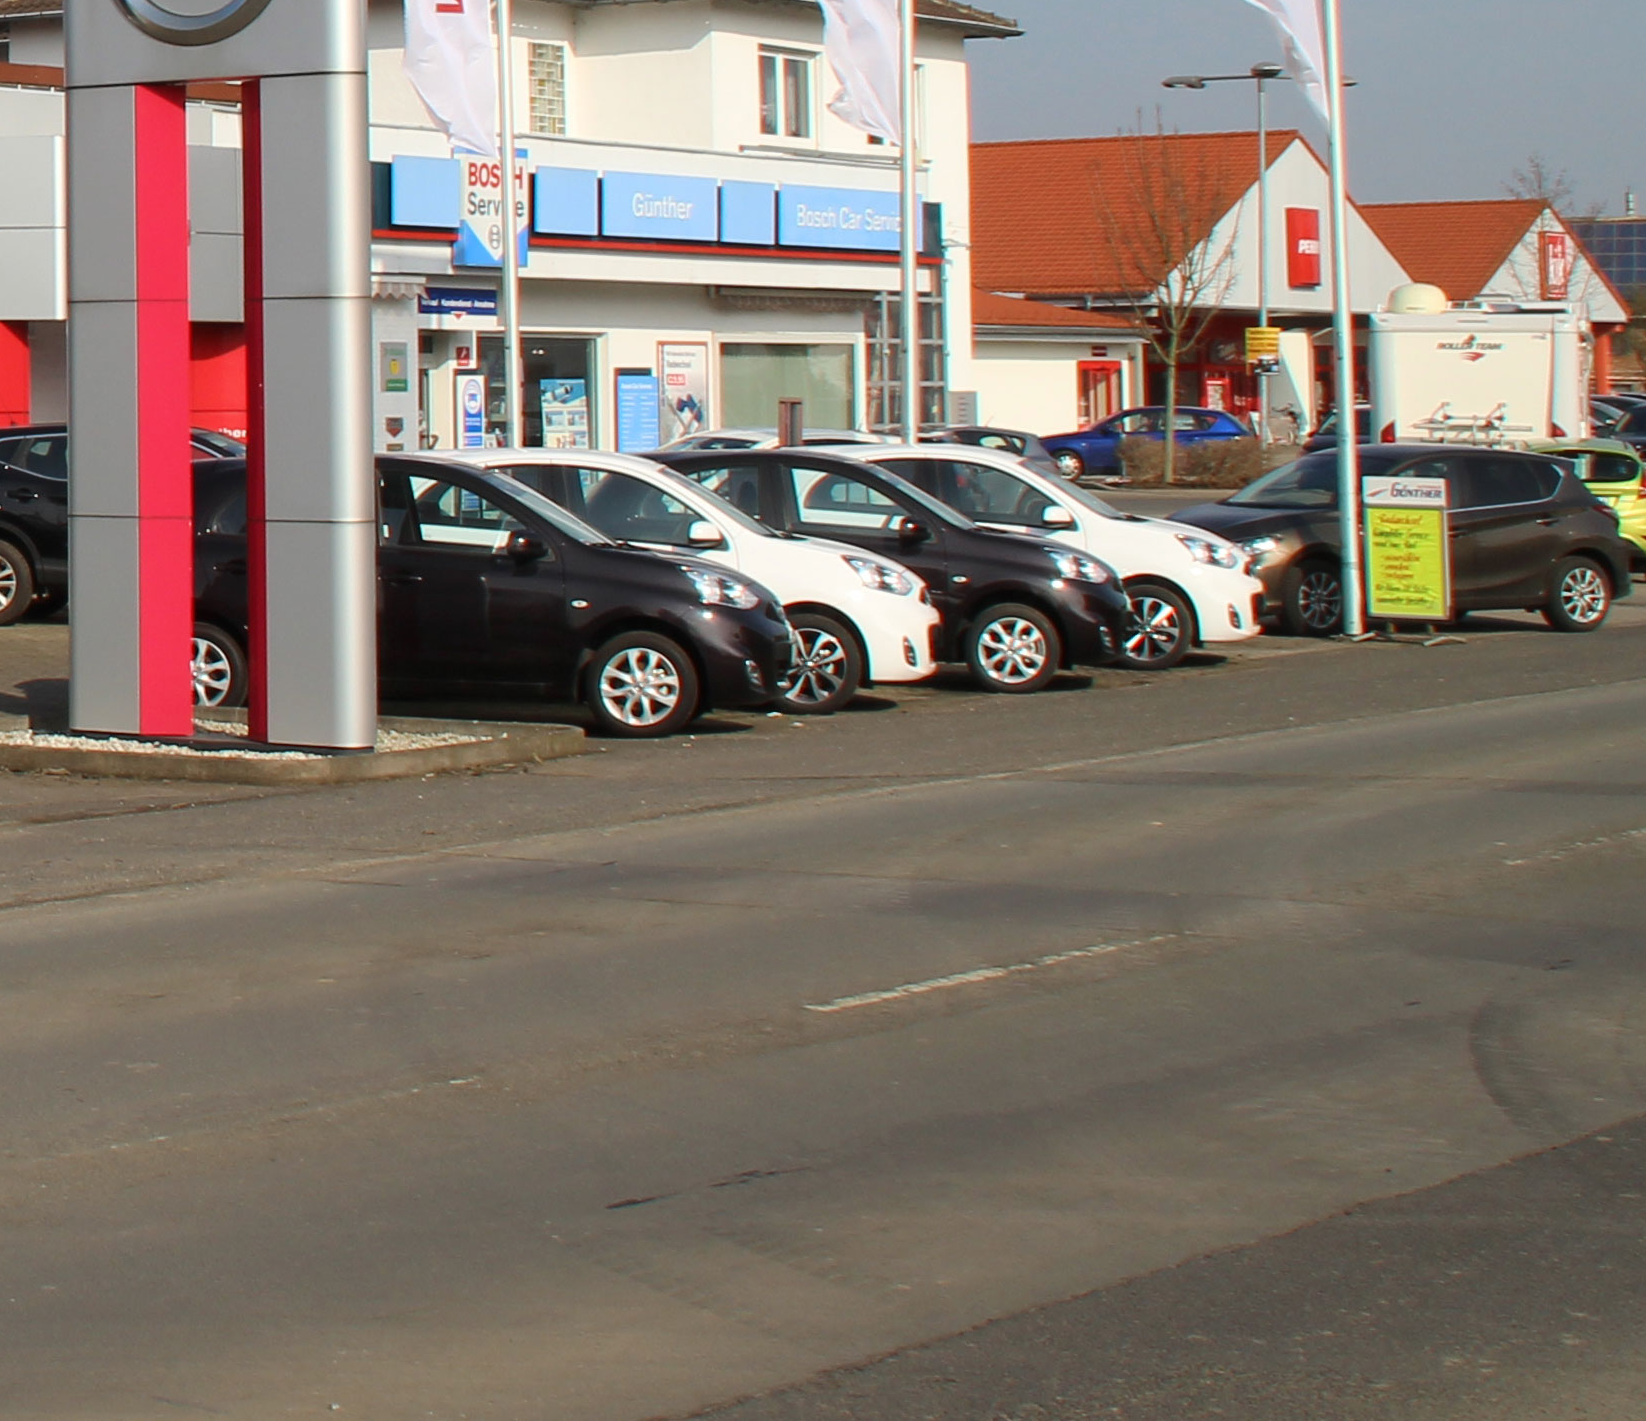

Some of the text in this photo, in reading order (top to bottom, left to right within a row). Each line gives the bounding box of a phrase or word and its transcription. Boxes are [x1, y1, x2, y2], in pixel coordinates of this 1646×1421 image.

[467, 161, 524, 190] BOSH
[467, 191, 525, 218] Serve
[631, 192, 693, 220] Günther
[796, 203, 902, 233] Bosch Car Servic
